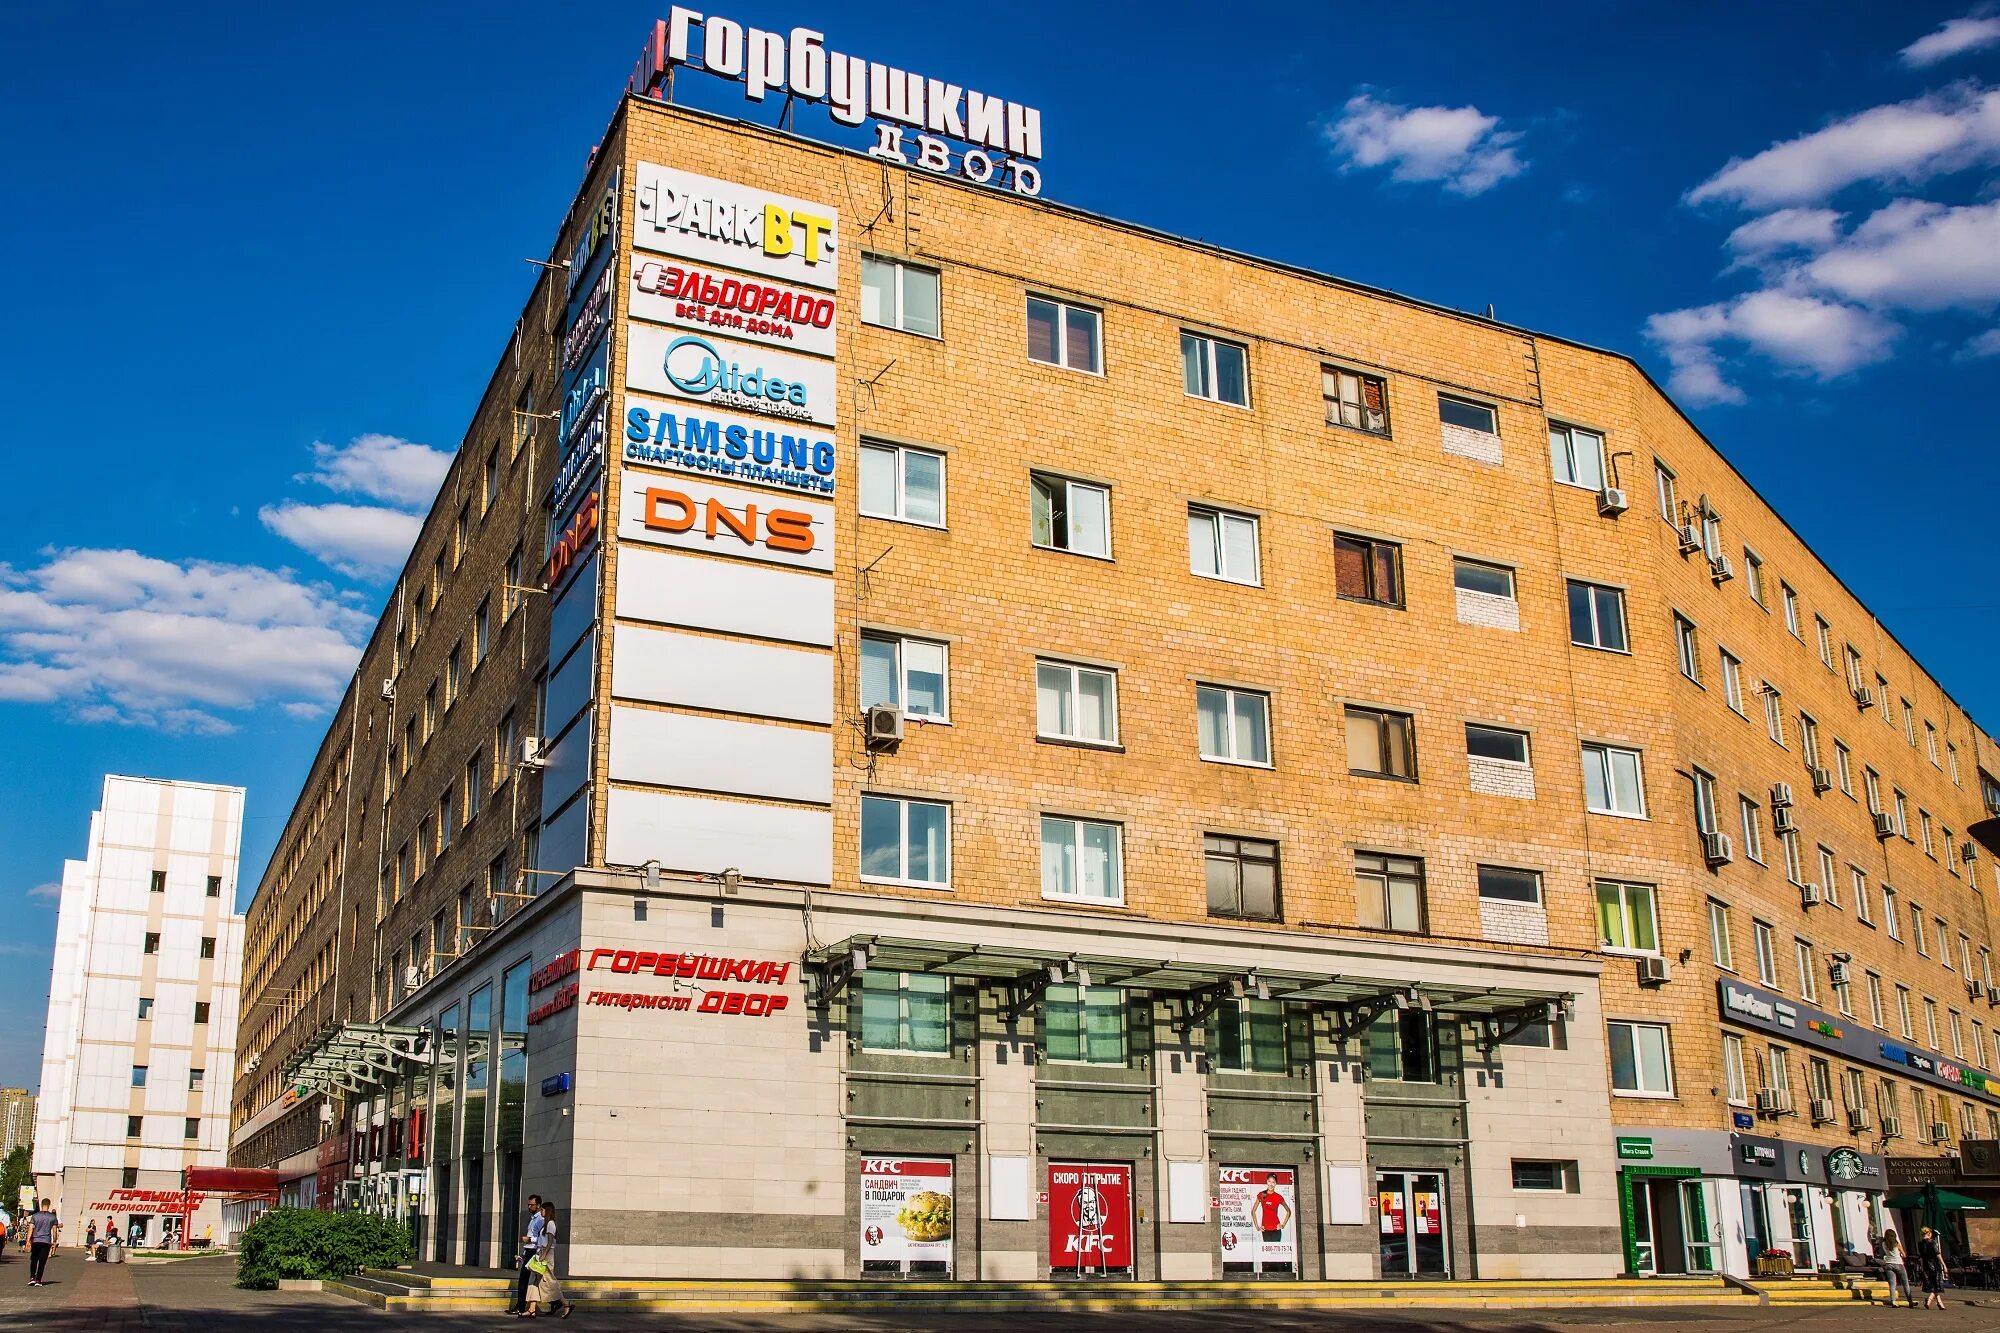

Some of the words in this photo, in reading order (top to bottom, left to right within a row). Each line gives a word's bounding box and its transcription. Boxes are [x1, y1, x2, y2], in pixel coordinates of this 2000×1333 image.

[709, 310, 743, 330] ДЛЯ
[745, 317, 794, 340] ДОМА
[664, 335, 807, 407] Midea
[711, 392, 760, 412] БЫТОВАЯ
[761, 401, 813, 421] ТЕХНИКА
[626, 407, 835, 474] SAMSUNG
[625, 442, 736, 478] СМАРТФОНЫ
[741, 462, 835, 494] ПЛАНШЕТЫ
[645, 487, 815, 552] DNS
[586, 948, 791, 986] ГОРБУШКИН
[586, 990, 693, 1012] гипермолл
[697, 990, 789, 1017] ДВОР
[864, 1159, 902, 1174] KFC
[1887, 1168, 1957, 1176] ЕЛЕВИЗИОННЫЙ
[1890, 1160, 1952, 1168] МОСКОВСКИЙ
[1053, 1172, 1079, 1185] СКОРО
[1219, 1169, 1250, 1183] KFC
[1907, 1175, 1937, 1183] ЗАВОД
[864, 1179, 898, 1191] САНДВИЧ
[864, 1190, 870, 1201] В
[872, 1190, 906, 1202] ПОДАРОК
[89, 1202, 156, 1214] гипермолл
[1064, 1234, 1114, 1253] KFC
